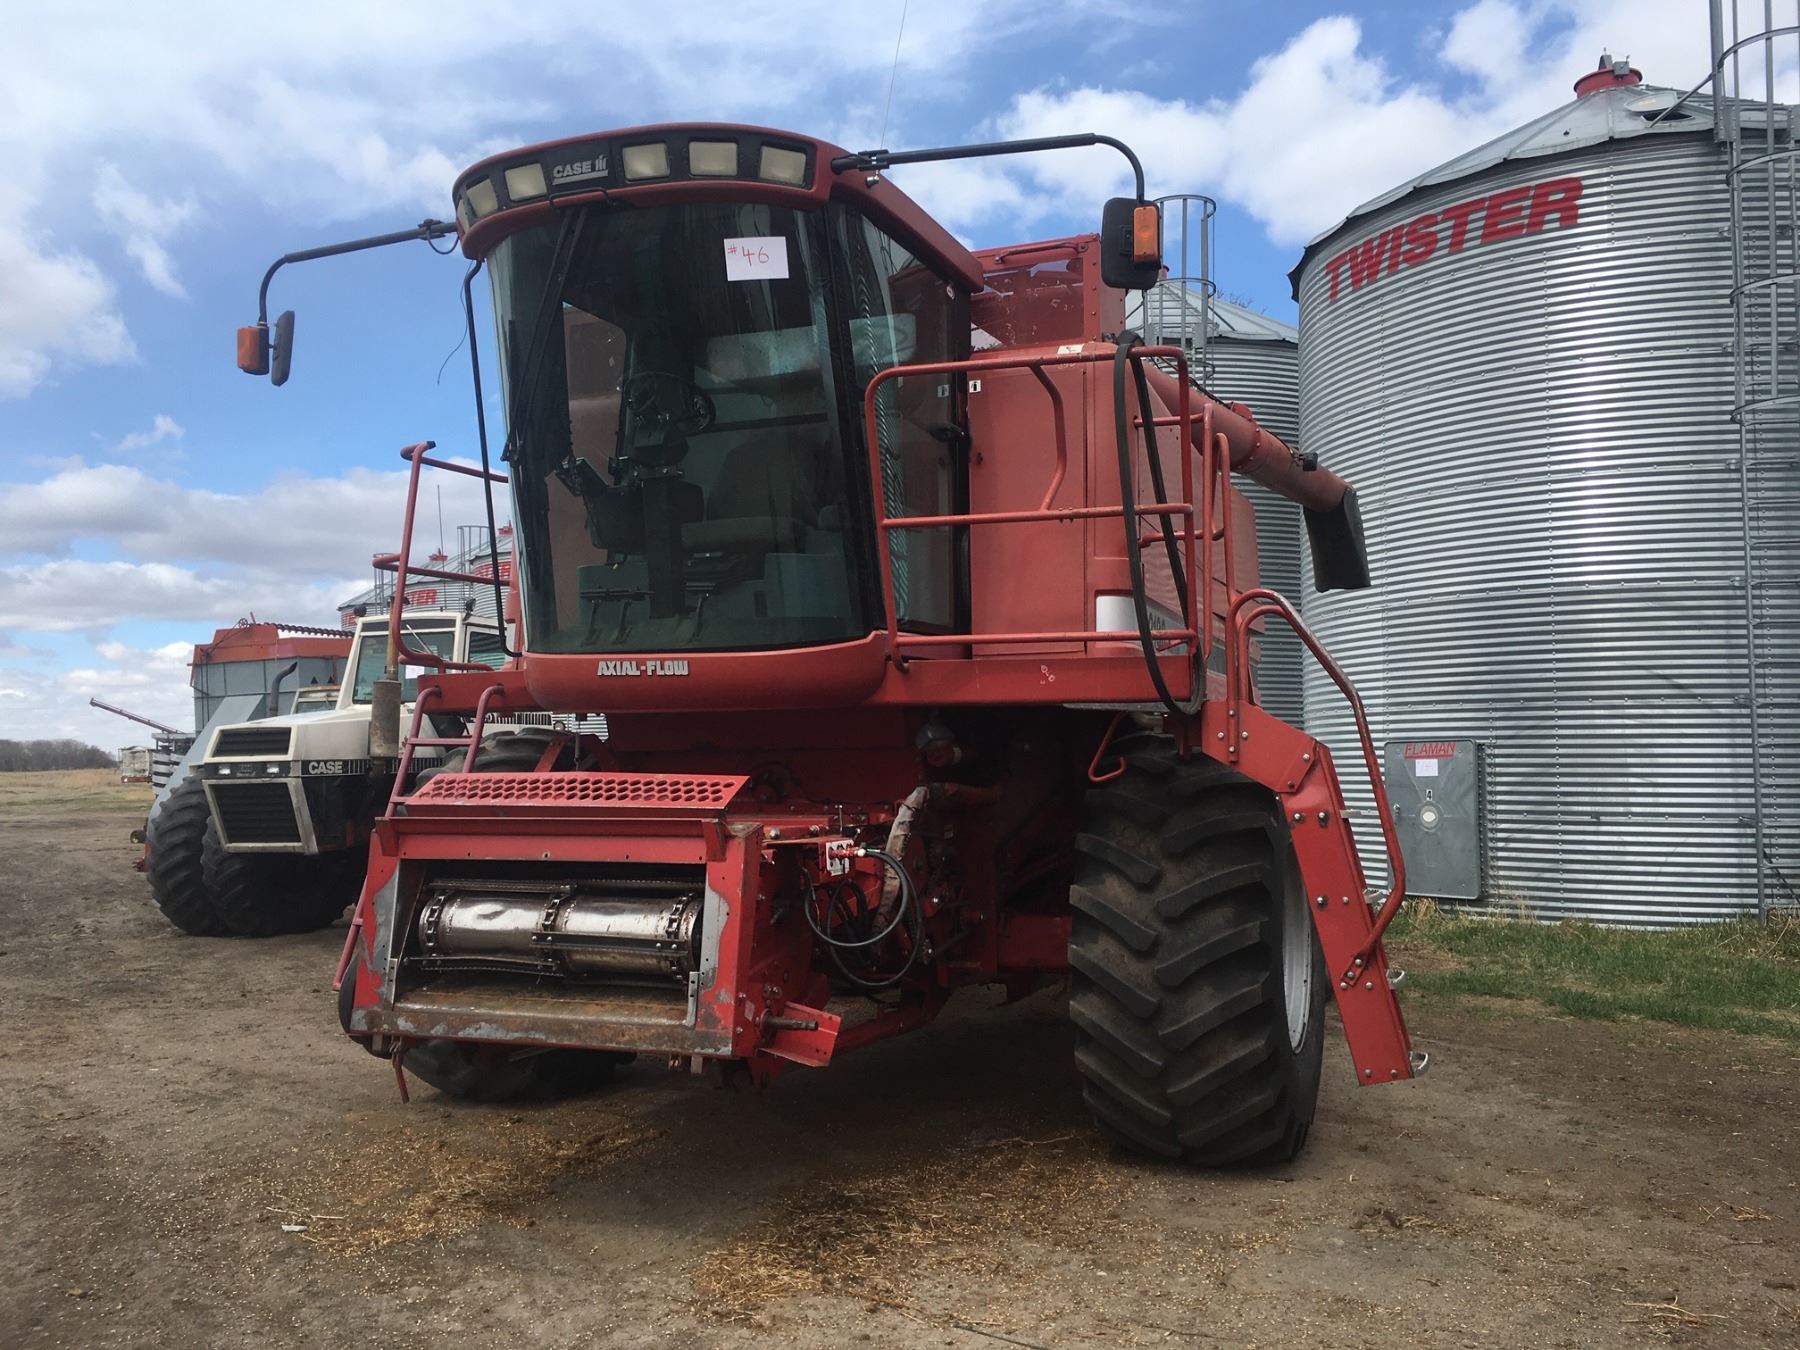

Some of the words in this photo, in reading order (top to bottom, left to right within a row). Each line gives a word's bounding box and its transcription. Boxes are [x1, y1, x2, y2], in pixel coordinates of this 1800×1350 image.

[553, 160, 592, 178] CASE
[1325, 177, 1584, 304] TWISTER
[597, 660, 689, 676] AXIAL-FLOW
[1404, 742, 1457, 756] FLAMAN
[308, 761, 343, 775] CASE
